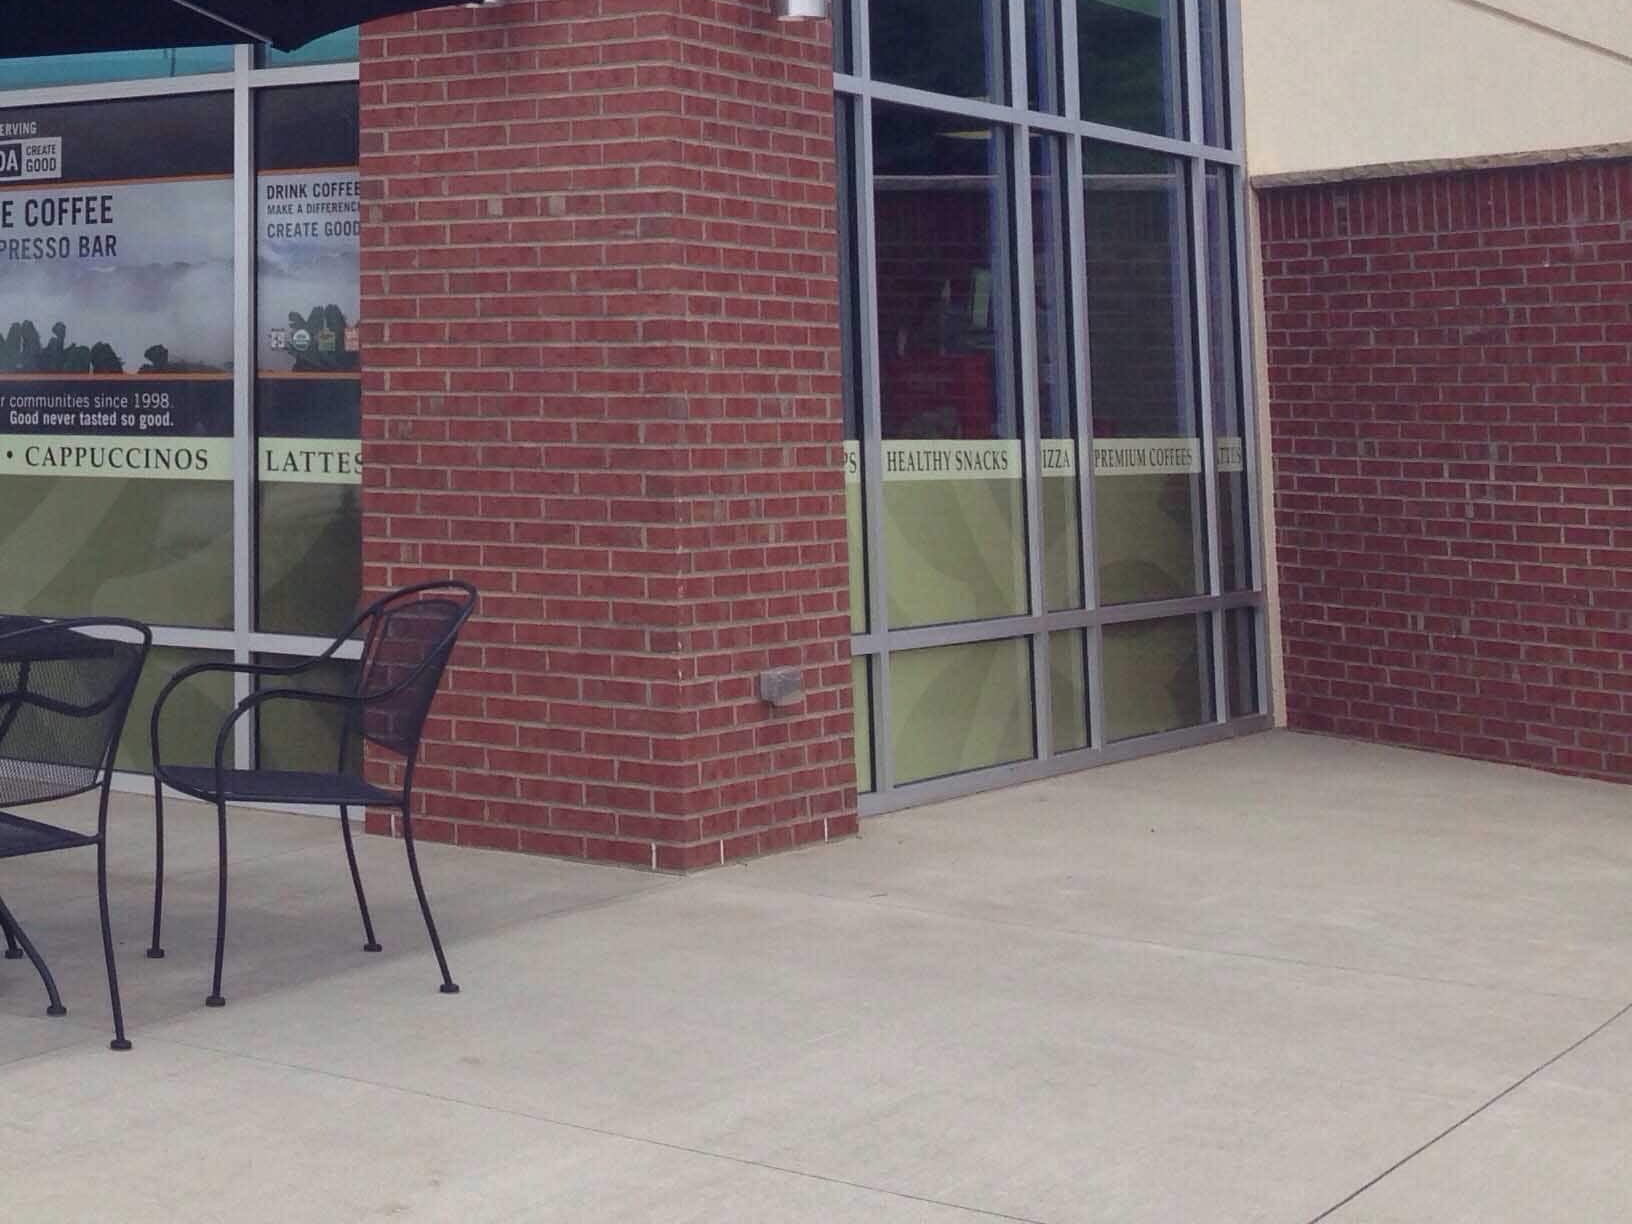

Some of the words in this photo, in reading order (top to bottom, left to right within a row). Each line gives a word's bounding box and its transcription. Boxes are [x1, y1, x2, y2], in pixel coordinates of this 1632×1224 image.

[26, 144, 56, 155] CREATE
[26, 157, 56, 173] GOOD
[267, 183, 308, 200] DRINK
[312, 181, 360, 198] COFFEE
[24, 195, 113, 227] COFFEE
[267, 203, 294, 215] MAKE
[297, 203, 303, 214] A
[266, 222, 319, 239] CREATE
[324, 220, 360, 237] GOOD
[79, 235, 117, 258] BAR
[9, 393, 90, 408] communities
[94, 393, 128, 408] since
[9, 411, 39, 425] Good
[43, 413, 76, 425] never
[79, 412, 117, 426] tasted
[120, 414, 135, 426] so
[139, 412, 174, 430] good.
[25, 446, 208, 471] CAPPUCCINOS
[265, 449, 363, 474] LATTES
[886, 450, 952, 472] HEALTHY
[954, 450, 1008, 471] SNACKS
[1042, 448, 1070, 469] IZZA
[1094, 448, 1146, 468] PREMIUM
[1149, 447, 1193, 467] COFFEES
